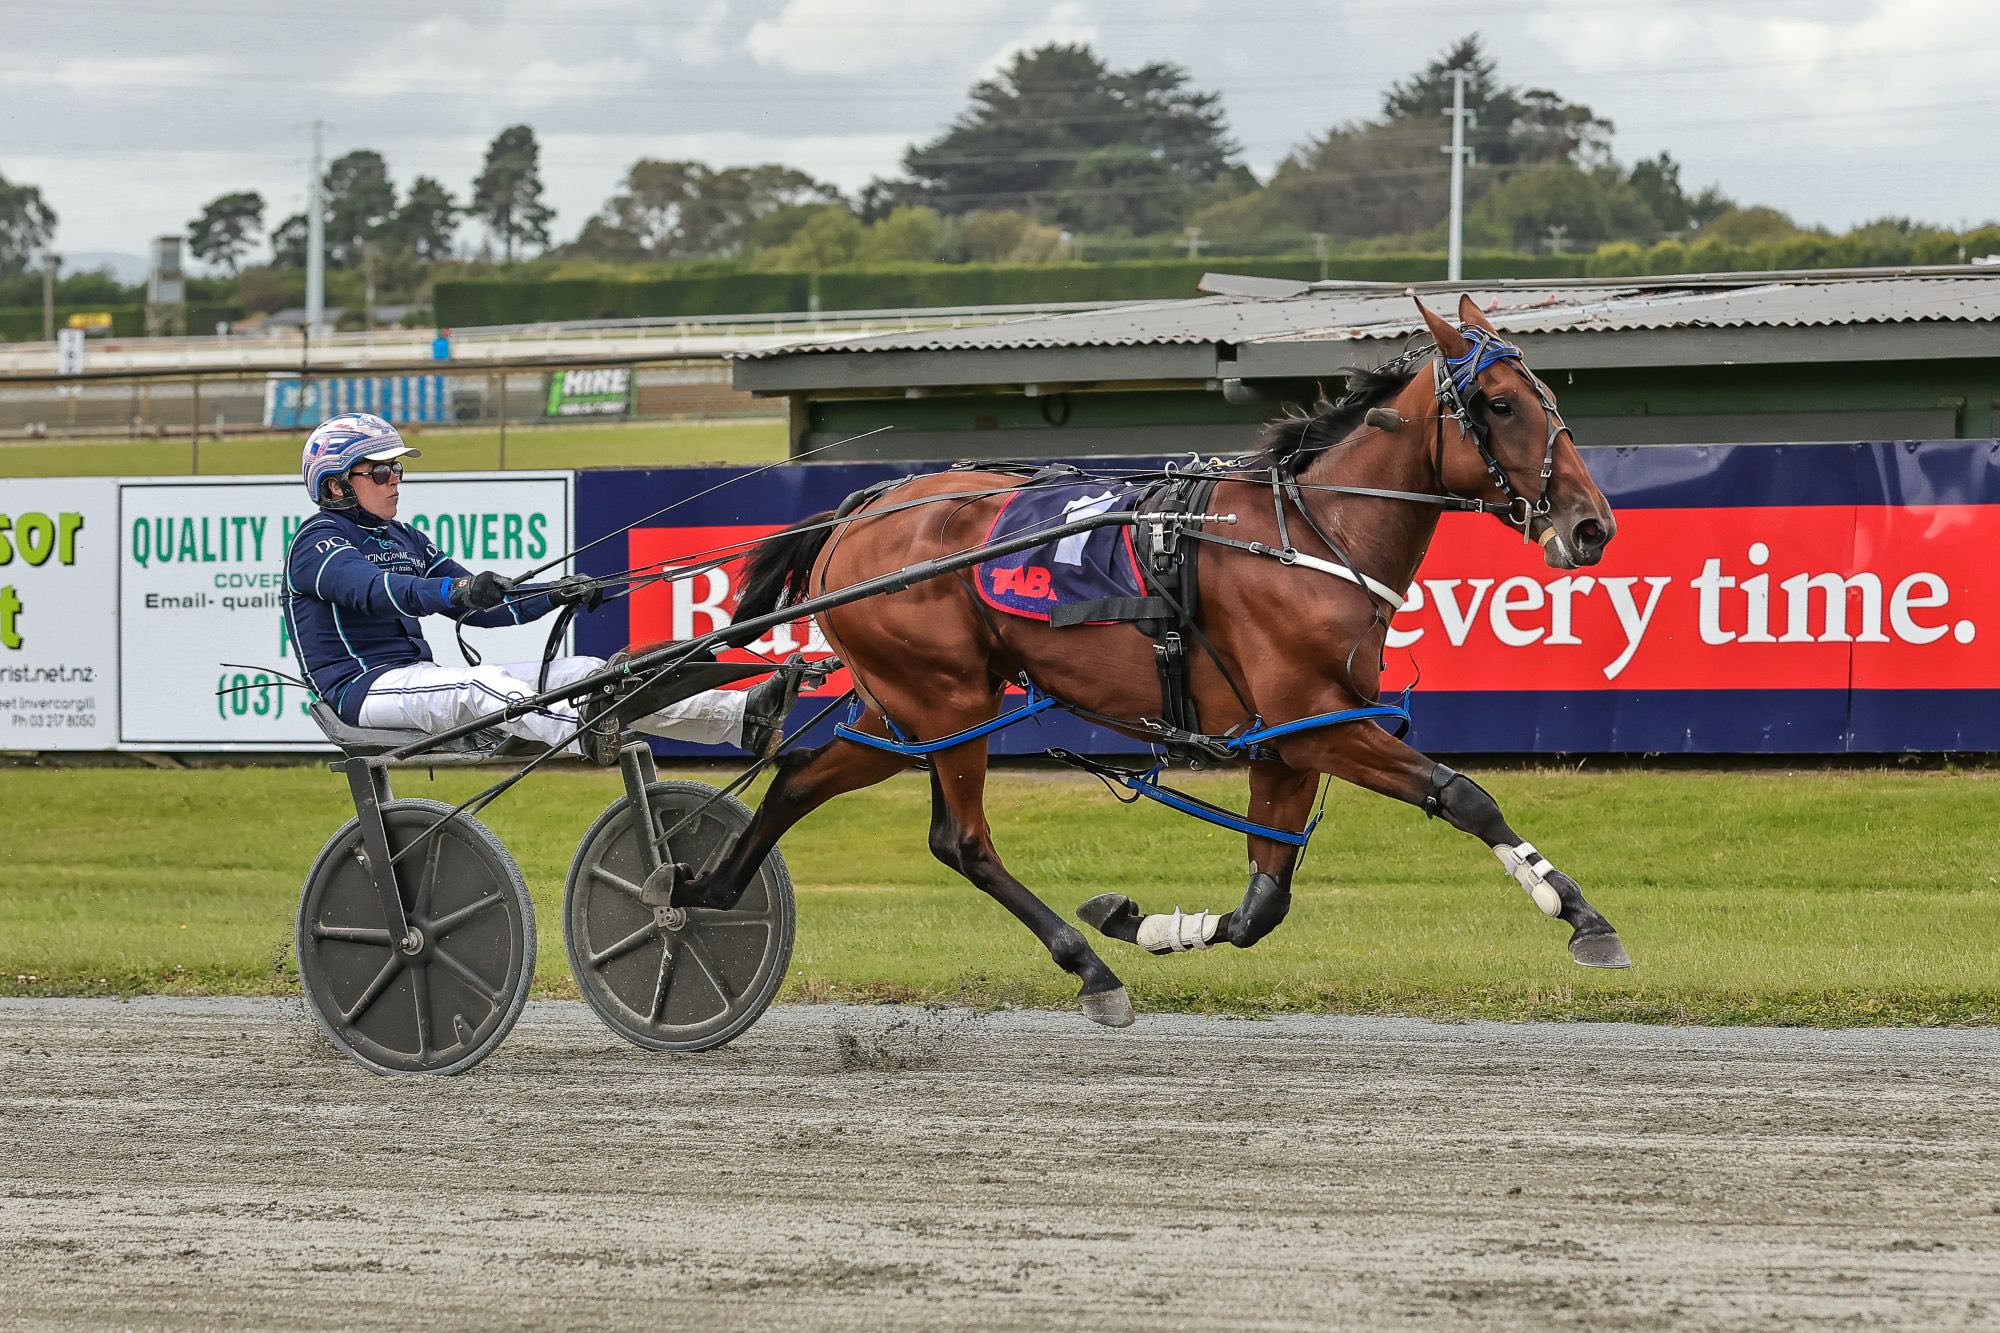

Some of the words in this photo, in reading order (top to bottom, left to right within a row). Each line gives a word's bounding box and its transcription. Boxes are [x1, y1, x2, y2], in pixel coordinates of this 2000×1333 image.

[133, 517, 267, 568] QUALITY
[145, 593, 214, 608] Email-
[990, 565, 1057, 600] TAB
[1384, 576, 1672, 681] every
[1690, 541, 1977, 646] time.
[19, 697, 96, 712] Invercargill
[217, 673, 283, 720] (03)
